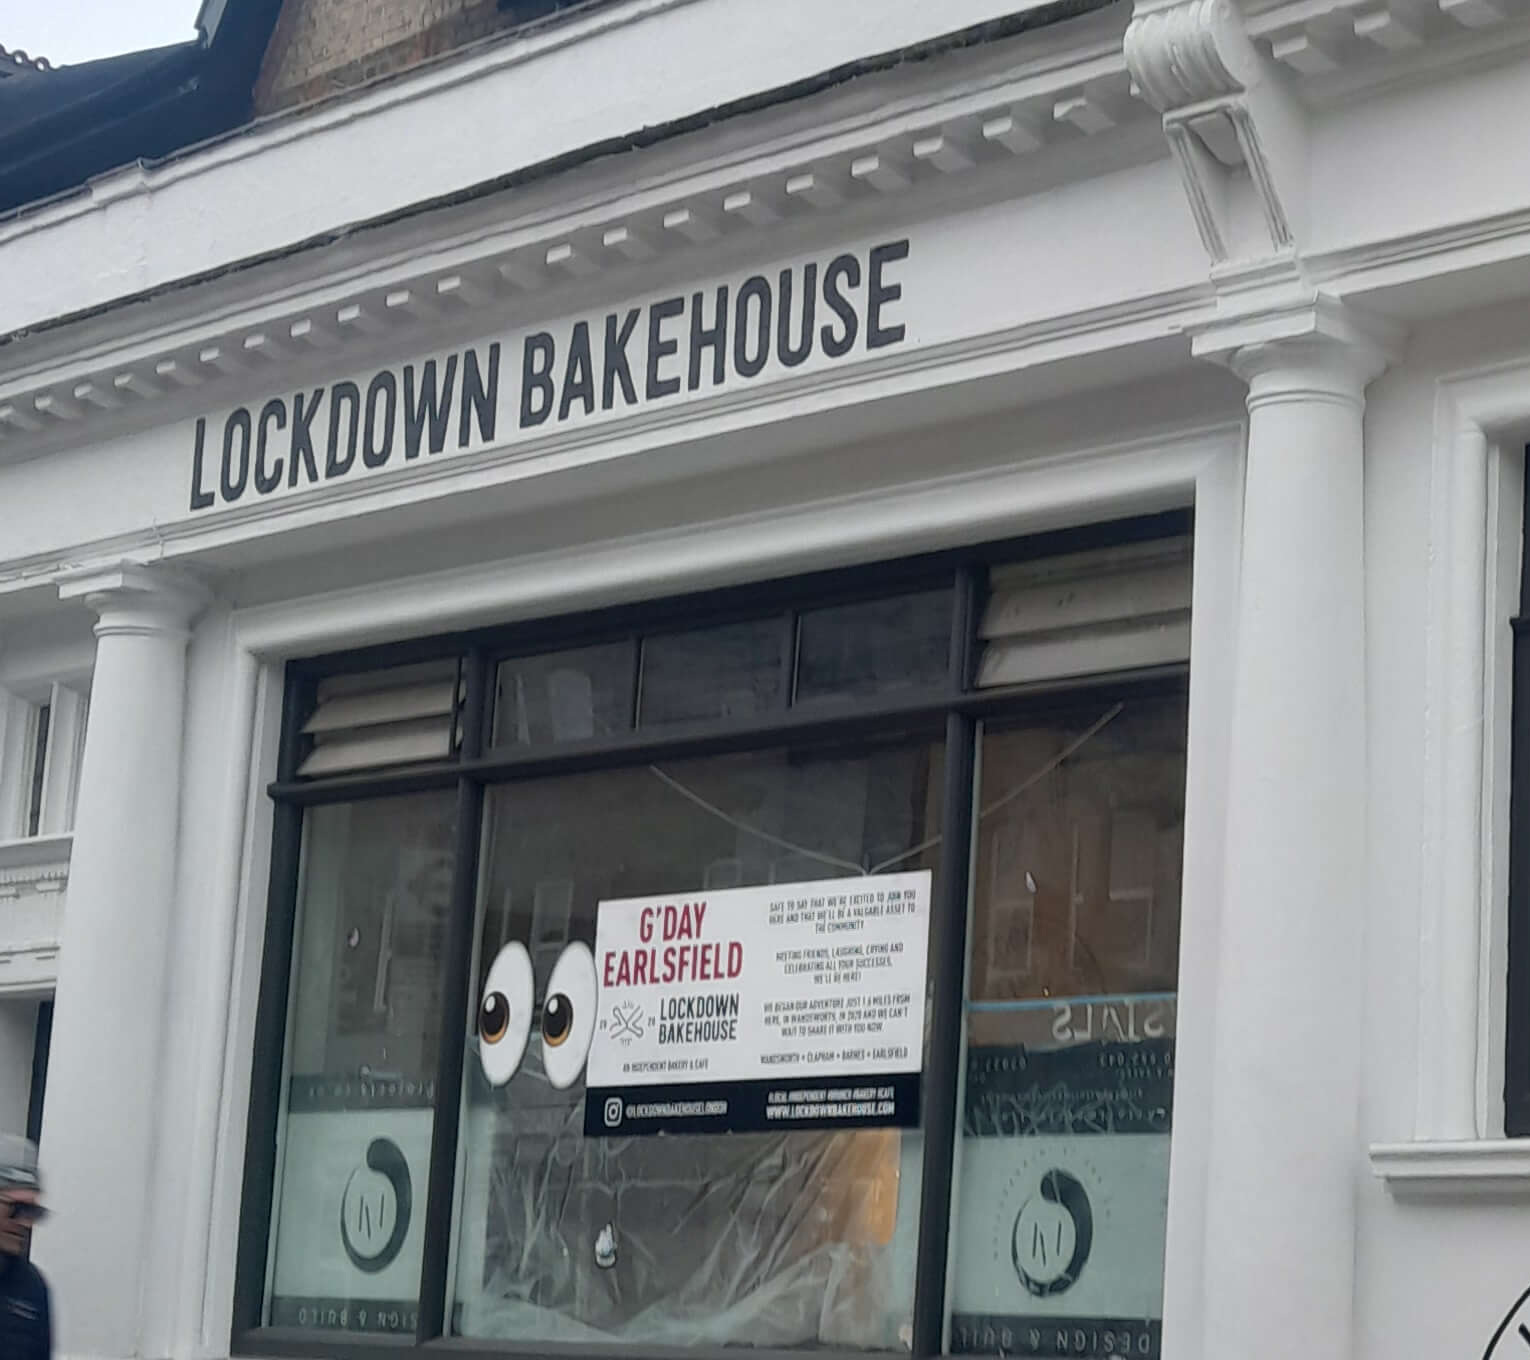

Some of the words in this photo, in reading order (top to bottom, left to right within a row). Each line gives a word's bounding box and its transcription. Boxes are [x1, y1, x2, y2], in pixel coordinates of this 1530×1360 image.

[190, 341, 500, 511] LOCKDOWN
[519, 239, 912, 429] BAKEHOUSE
[786, 913, 799, 923] AND
[886, 903, 905, 915] ASSET
[908, 902, 915, 913] TO
[640, 902, 707, 943] G'DAY
[890, 943, 904, 954] AND
[604, 942, 743, 987] EARLSFIELD
[826, 959, 836, 970] ALL
[660, 992, 740, 1020] LOCKDOWN
[809, 997, 844, 1010] ADVENTURE
[846, 996, 860, 1008] JUST
[873, 994, 891, 1006] MILES
[893, 993, 910, 1005] FROM
[863, 1010, 876, 1020] AND
[659, 1019, 737, 1044] BAKEHOUSE
[808, 1024, 827, 1036] SHARE
[807, 1051, 835, 1063] CLAPHAM
[842, 1049, 864, 1061] BARNES
[873, 1046, 908, 1060] EARLSFIELD
[668, 1059, 688, 1070] BAKERY
[766, 1102, 895, 1120] WWW.LOCKDOWNBAKEHOUSE.COM
